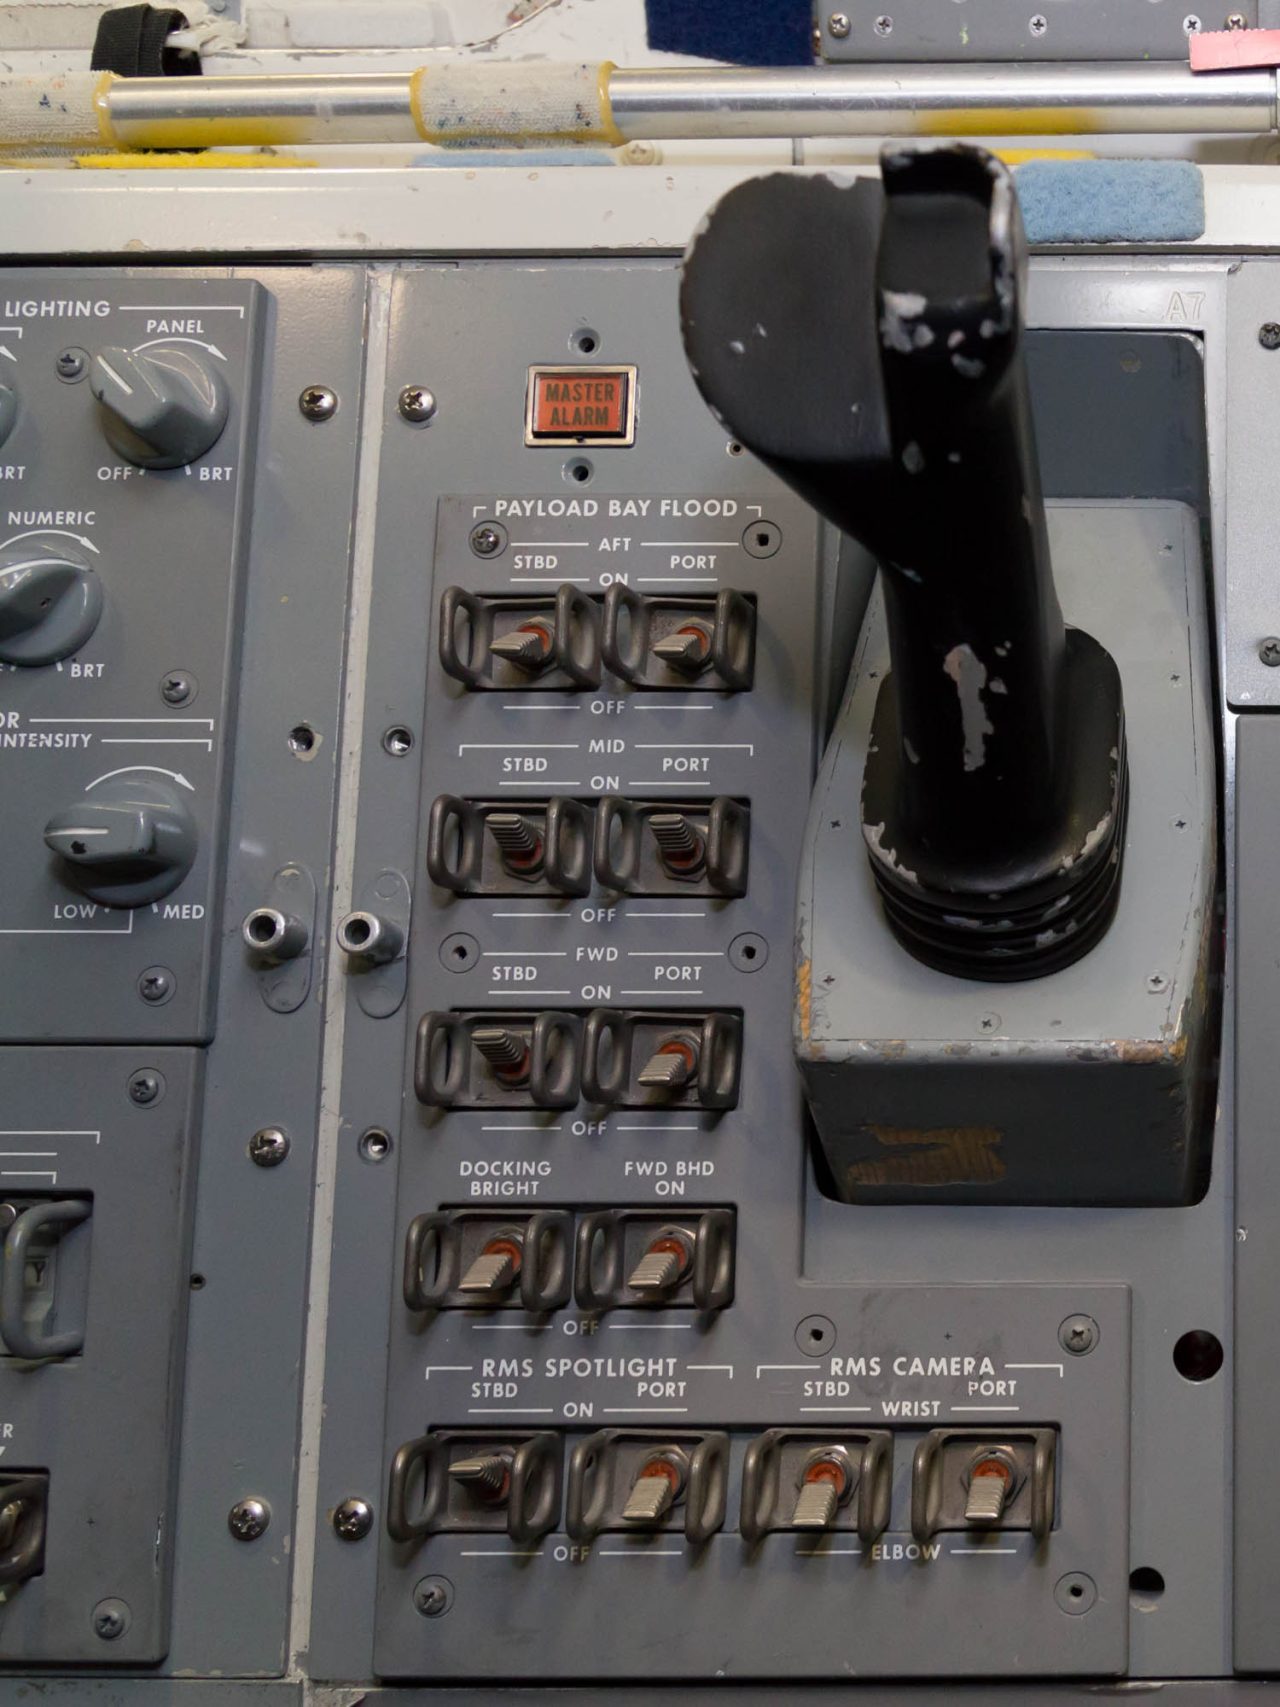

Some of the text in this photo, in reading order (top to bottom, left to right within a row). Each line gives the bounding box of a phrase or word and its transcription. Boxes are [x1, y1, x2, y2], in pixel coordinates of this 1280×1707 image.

[5, 300, 111, 317] LIGHTING
[1166, 291, 1206, 321] A7
[146, 319, 204, 333] PANEL
[546, 383, 614, 402] MASTER
[550, 406, 609, 426] ALARM
[97, 467, 132, 480] OFF
[200, 466, 233, 480] BRT
[495, 499, 738, 517] PAYLOAD BAY FLOOD
[8, 511, 96, 525] NUMERIC
[598, 538, 632, 551] AFT
[514, 555, 558, 569] STBD
[670, 555, 716, 569] PORT
[599, 573, 628, 587] ON
[71, 663, 104, 677] BRT
[591, 701, 625, 714] OFF
[589, 739, 625, 753] MID
[503, 758, 548, 772] STBD
[663, 758, 710, 772] PORT
[590, 776, 619, 790] ON
[54, 904, 96, 918] LOW
[163, 905, 204, 919] MED
[581, 908, 616, 922] OFF
[576, 947, 618, 961] FWD
[492, 966, 537, 980] STBD
[654, 966, 701, 980] PORT
[581, 985, 611, 999] ON
[572, 1121, 607, 1136] OFF
[460, 1161, 552, 1176] DOCKING
[625, 1161, 714, 1176] FWD BHD
[470, 1181, 539, 1195] BRIGHT
[655, 1181, 684, 1195] ON
[563, 1321, 599, 1335] OFF
[482, 1358, 677, 1377] RMS SPOTLIGHT
[831, 1357, 995, 1376] RMS CAMERA
[472, 1383, 518, 1398] STBD
[637, 1382, 687, 1397] PORT
[804, 1381, 850, 1396] STBD
[967, 1381, 1016, 1396] PORT
[563, 1403, 593, 1417] ON
[881, 1401, 941, 1416] WRIST
[553, 1546, 589, 1561] OFF
[871, 1544, 941, 1560] ELBOW
